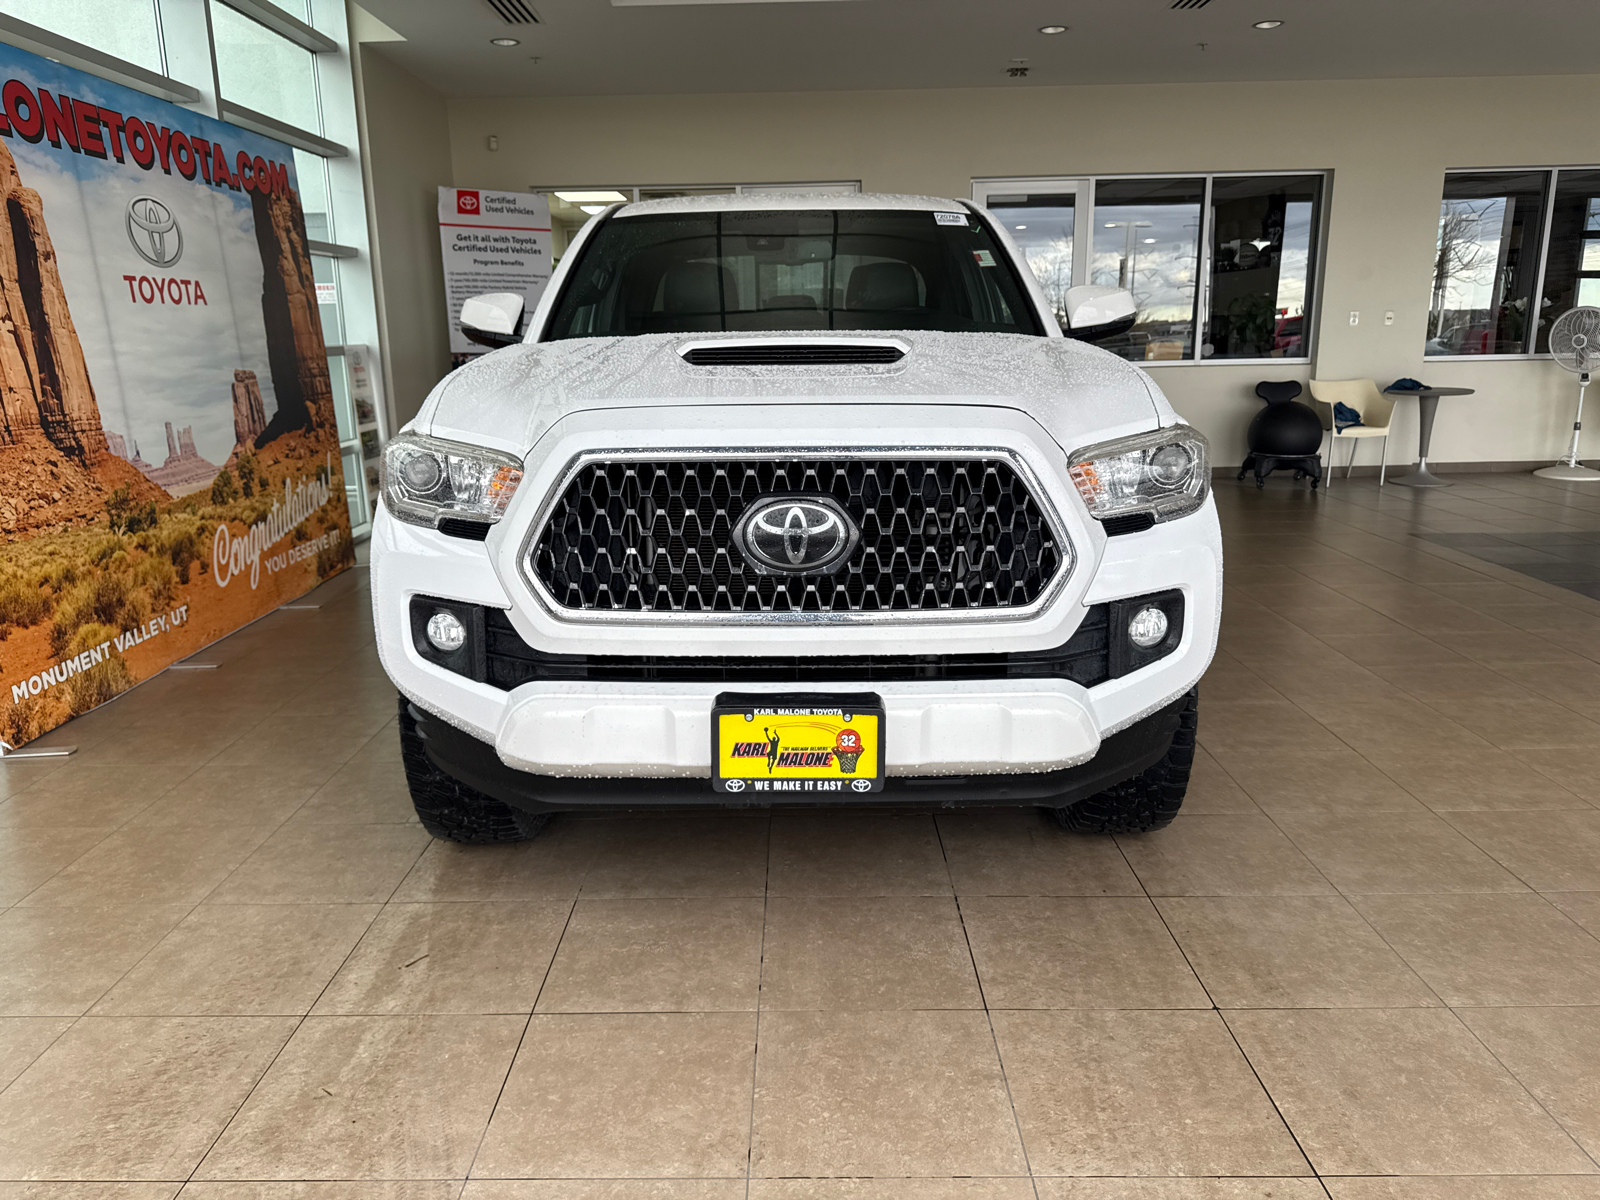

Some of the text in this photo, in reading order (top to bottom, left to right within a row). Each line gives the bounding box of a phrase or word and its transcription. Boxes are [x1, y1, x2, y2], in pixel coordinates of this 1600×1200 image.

[484, 195, 516, 205] Certified
[485, 205, 534, 215] Used Vehicles
[456, 233, 537, 246] Get it all with Toyota
[452, 243, 542, 255] Certified Used Vehicles
[473, 258, 524, 267] Program Benefits
[123, 275, 207, 305] TOYOTA
[214, 451, 333, 590] Congratulations!
[265, 529, 341, 575] YOU DESERVE IT!
[11, 605, 188, 704] MONUMENT VALLEY, UT
[754, 708, 843, 716] KARL MALONE TOYOTA
[841, 734, 856, 747] 32
[731, 742, 769, 758] KARL
[777, 752, 833, 767] MALONE
[754, 780, 842, 790] WE MAKE IT EASY
